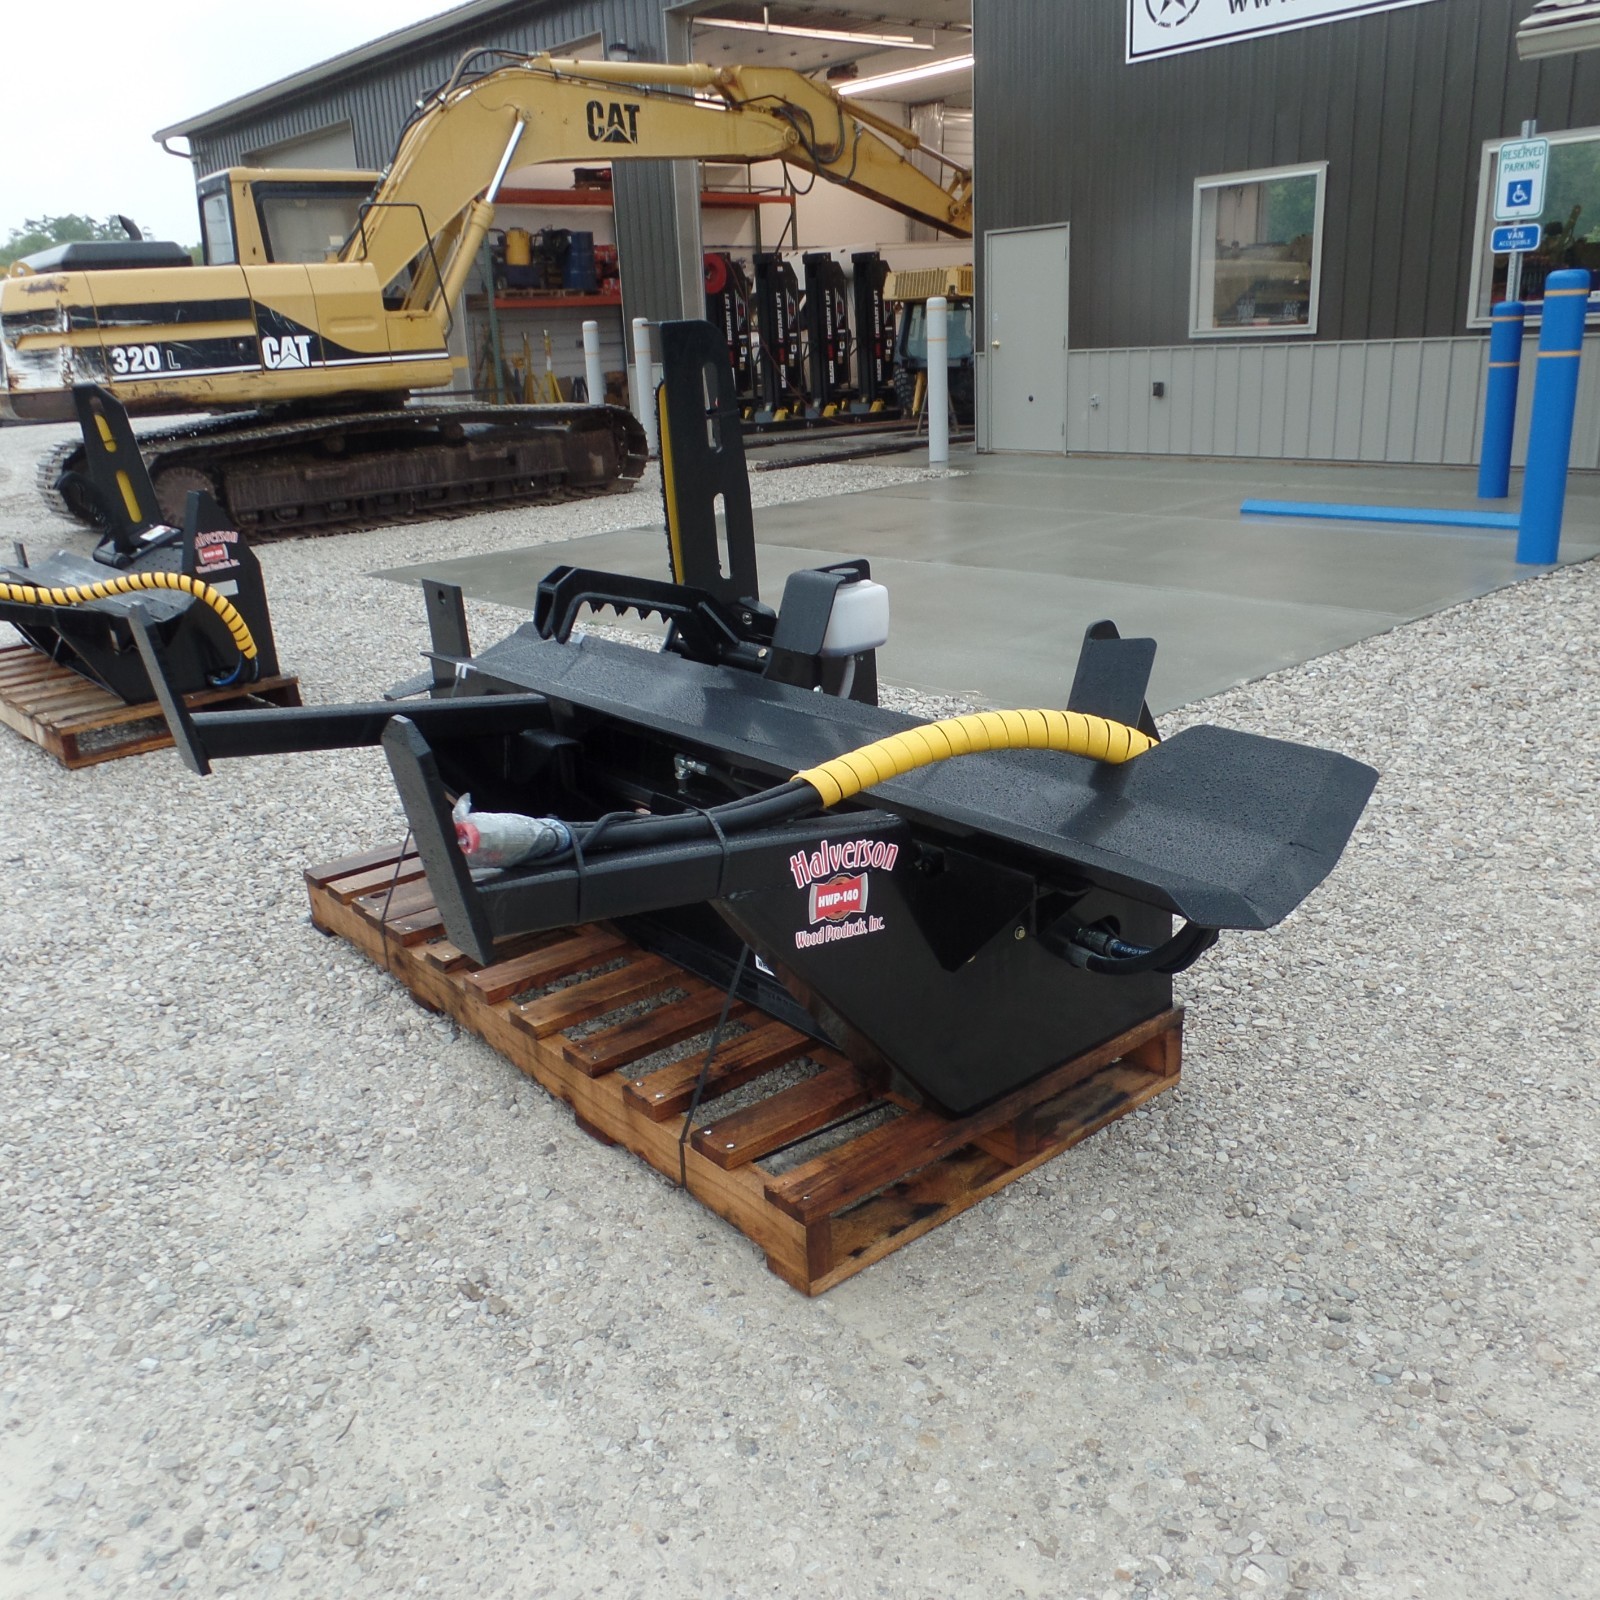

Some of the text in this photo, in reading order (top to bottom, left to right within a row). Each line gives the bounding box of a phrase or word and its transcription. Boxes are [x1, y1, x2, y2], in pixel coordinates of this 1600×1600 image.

[586, 100, 640, 144] CAT
[1502, 146, 1545, 160] RESERVED
[1504, 160, 1540, 173] PARKING
[1507, 231, 1525, 240] VAN
[111, 345, 181, 374] 320 L
[261, 335, 310, 369] CAT
[789, 839, 899, 889] Halverson
[818, 888, 859, 908] HWP-140
[795, 915, 885, 949] Wood Products, Inc.
